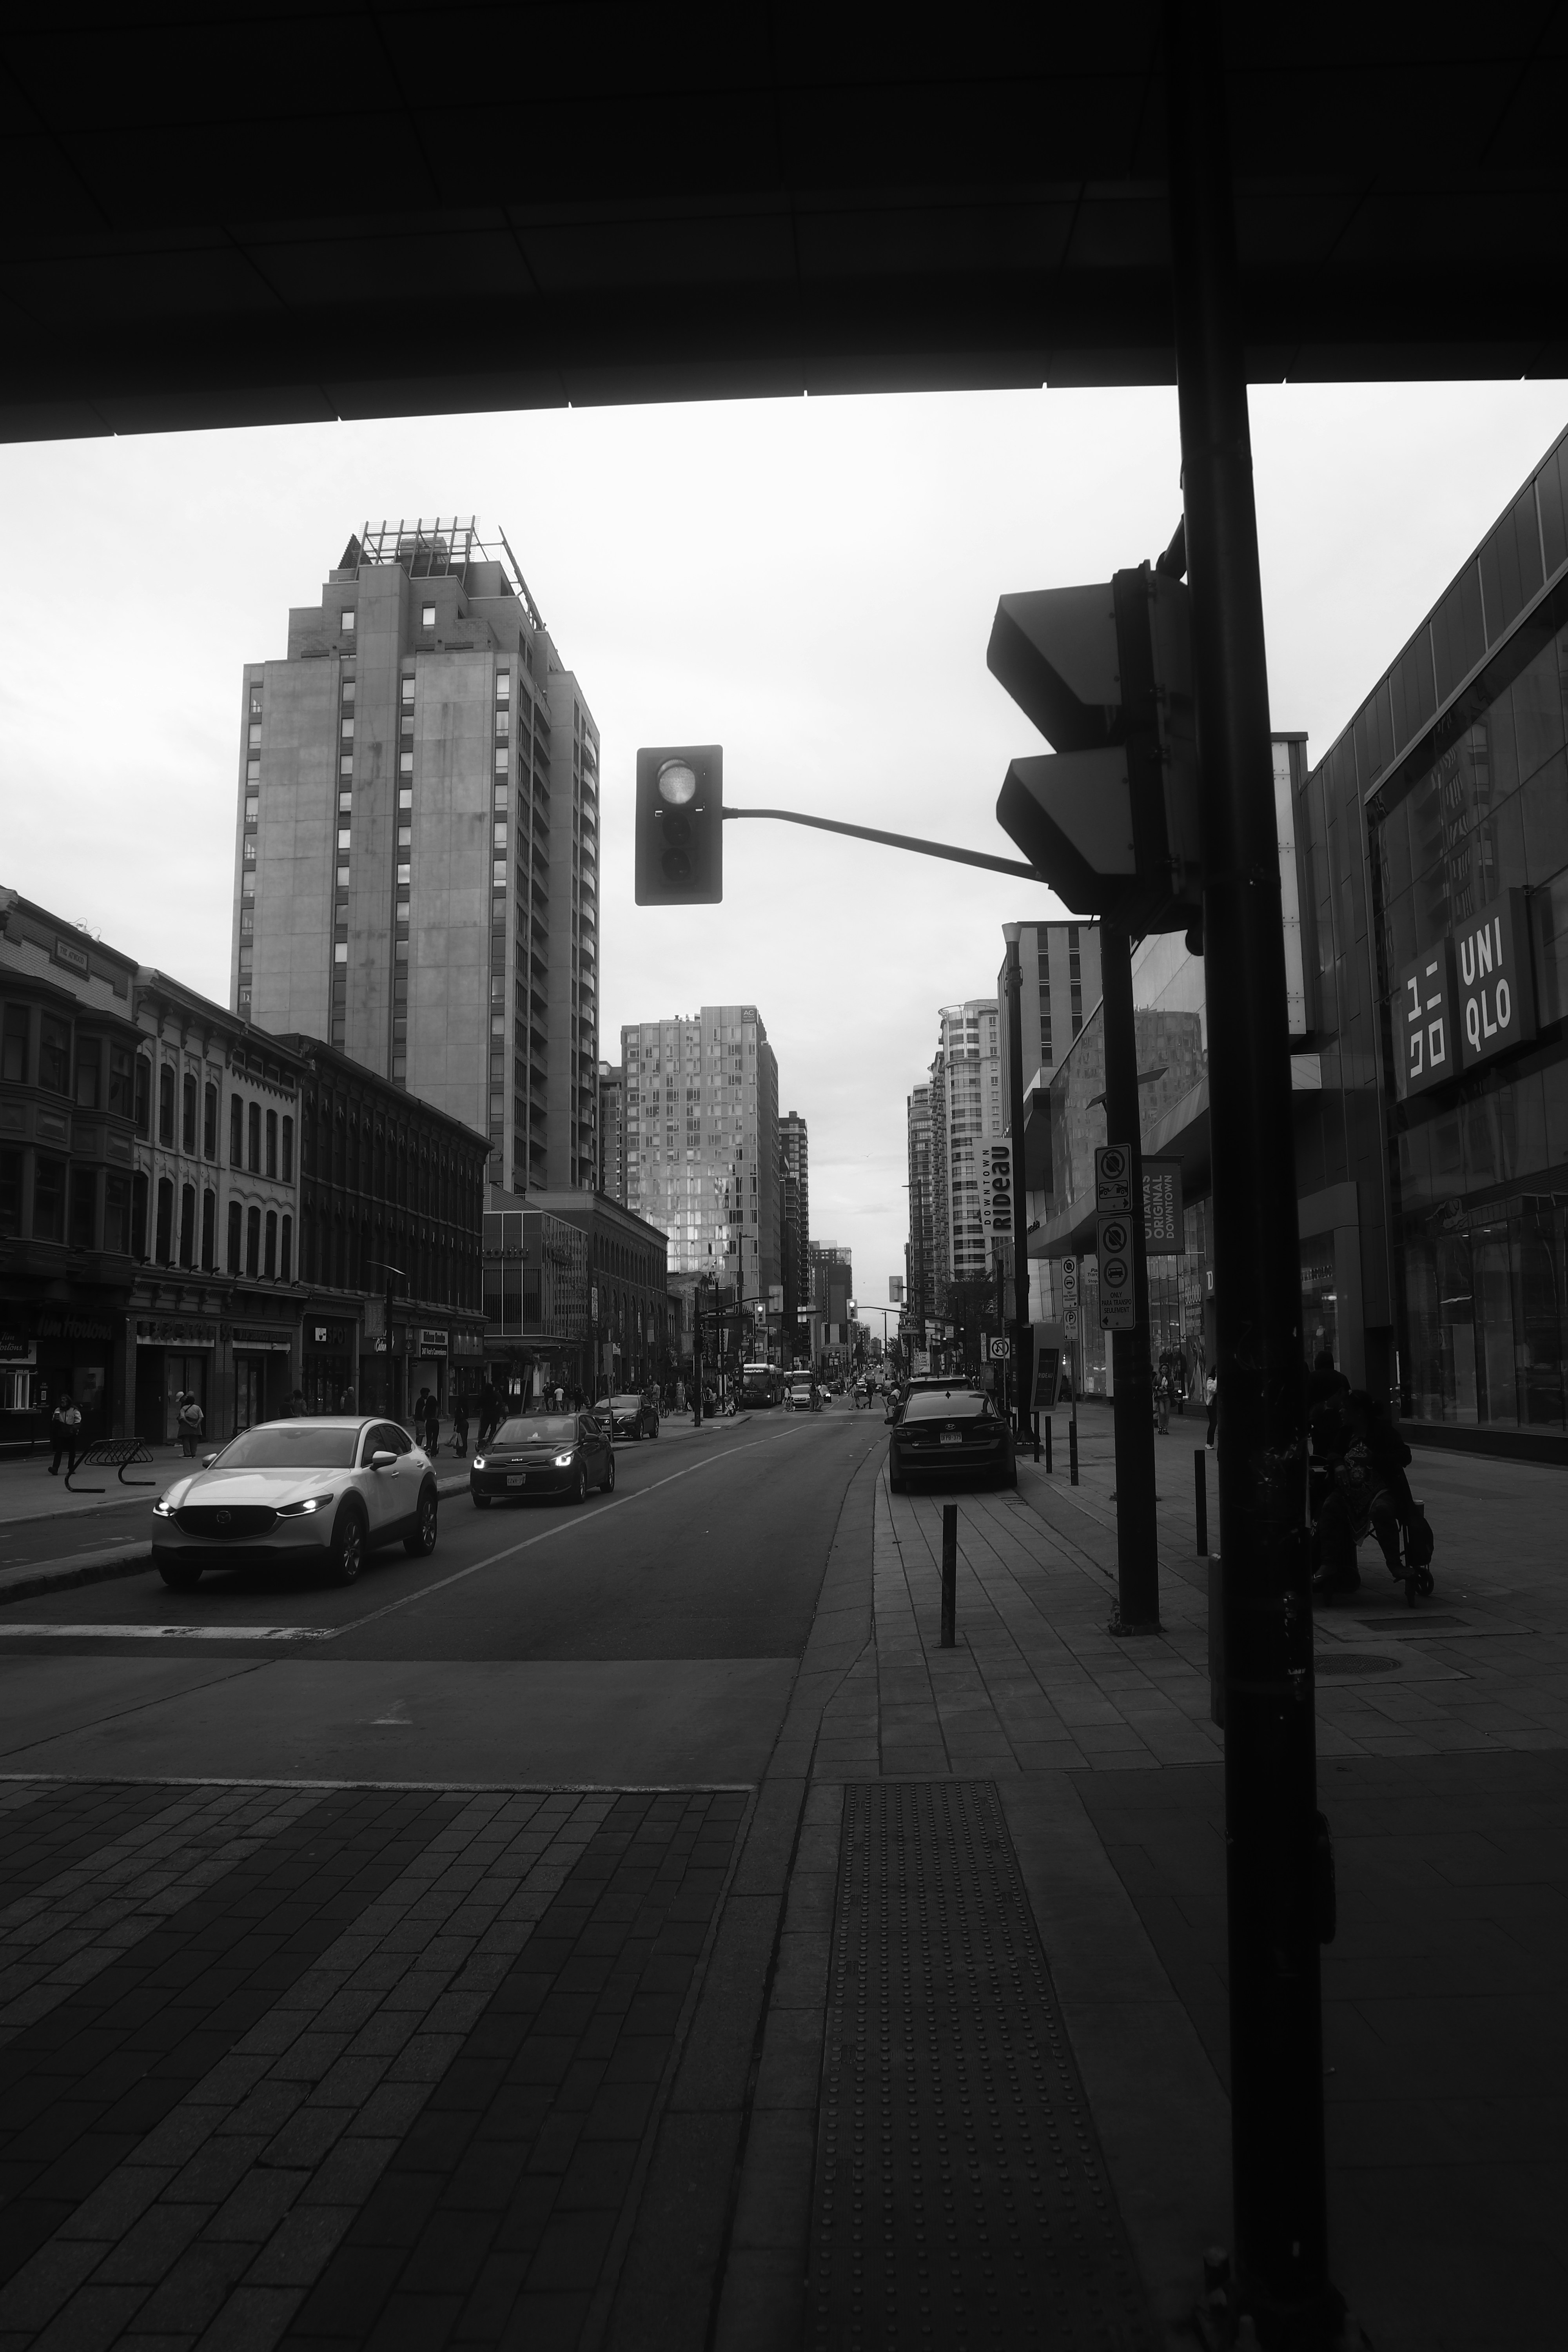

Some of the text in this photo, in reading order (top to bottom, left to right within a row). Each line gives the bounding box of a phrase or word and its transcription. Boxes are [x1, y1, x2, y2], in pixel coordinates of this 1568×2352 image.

[1461, 916, 1503, 986] UNI
[1466, 978, 1511, 1053] QLO
[982, 1150, 991, 1225] DOWNTOWN
[1152, 1175, 1164, 1239] ORIGINAL
[1164, 1175, 1174, 1239] DOWNTOWN
[483, 1243, 528, 1259] cotia
[2, 1332, 15, 1341] Tim
[37, 1311, 62, 1337] Tim
[63, 1313, 113, 1340] Hortons
